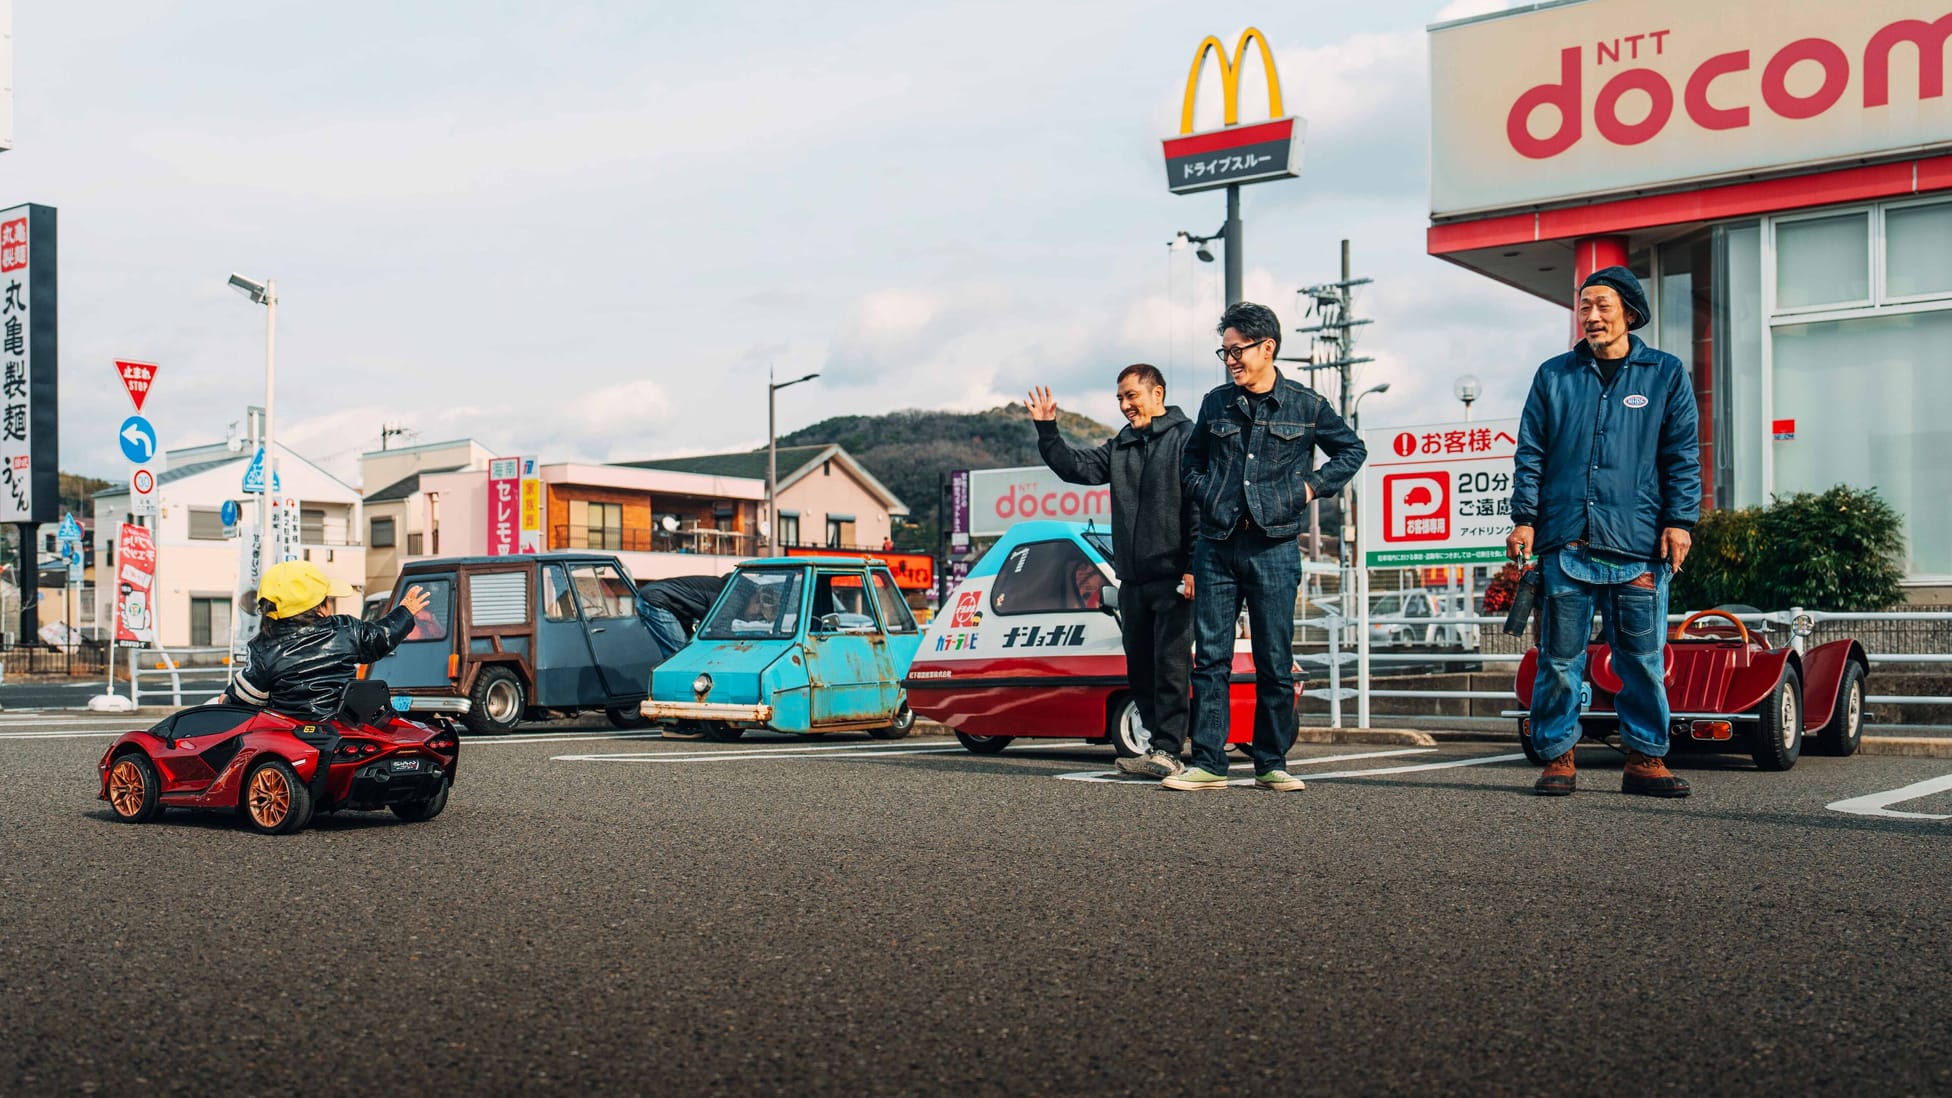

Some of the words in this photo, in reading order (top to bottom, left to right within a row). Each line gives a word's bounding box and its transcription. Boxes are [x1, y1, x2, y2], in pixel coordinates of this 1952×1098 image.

[1597, 30, 1670, 65] NTT
[1184, 154, 1272, 179] ドライブスルー
[2, 279, 27, 441] 丸亀製麺
[123, 365, 152, 380] 止まれ
[128, 380, 149, 392] STOP
[1421, 428, 1516, 454] お客様へ
[2, 456, 29, 511] うどん
[137, 474, 150, 489] 30
[936, 632, 978, 651] カラーテレビ
[1002, 624, 1086, 648] ナショナル
